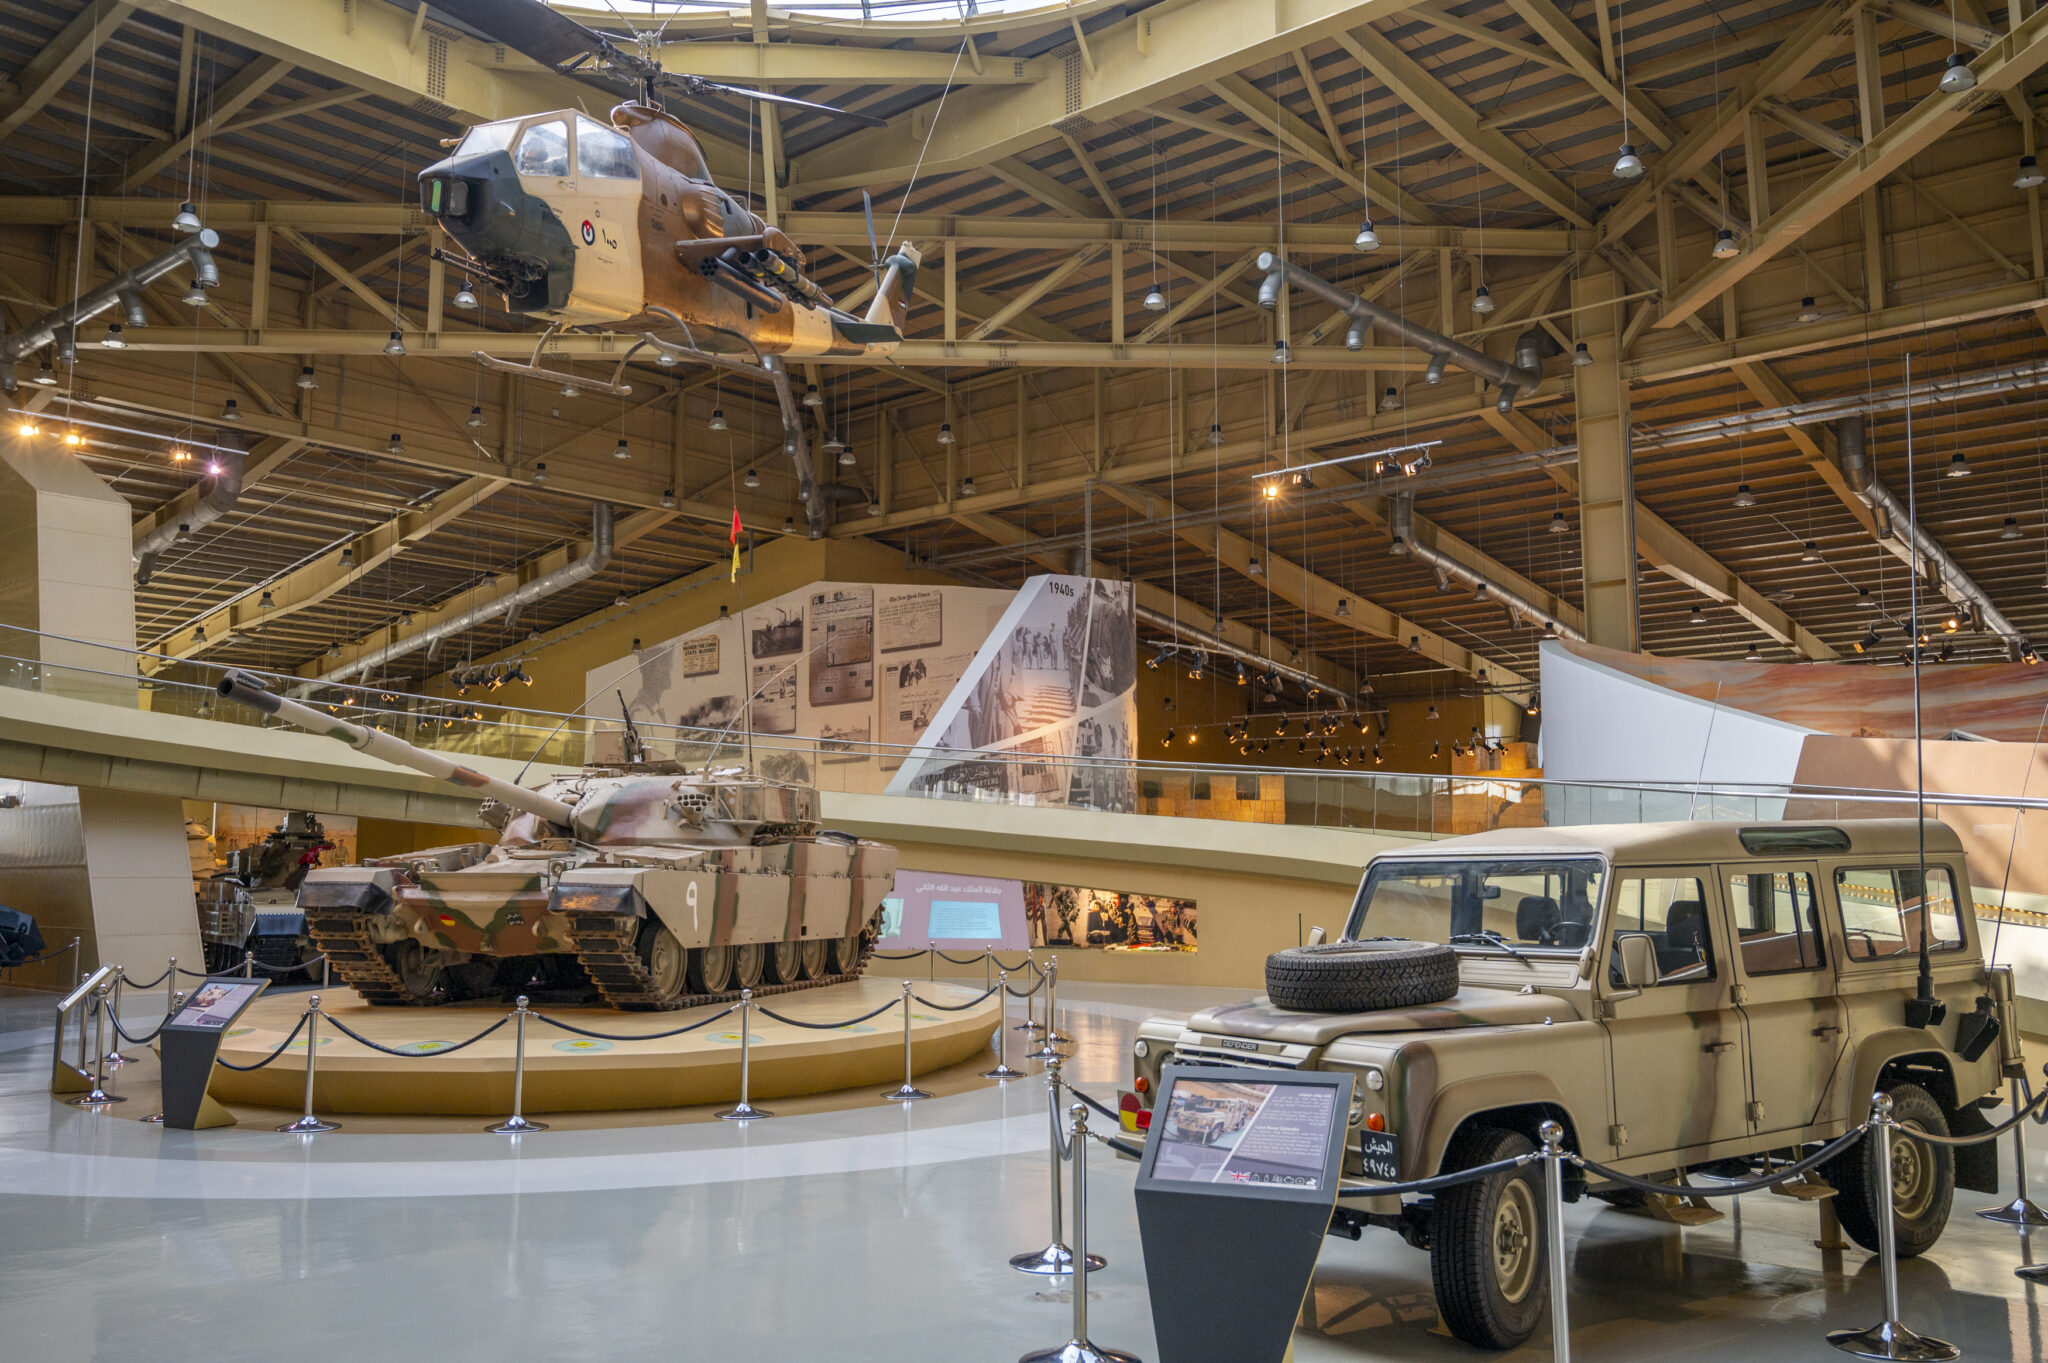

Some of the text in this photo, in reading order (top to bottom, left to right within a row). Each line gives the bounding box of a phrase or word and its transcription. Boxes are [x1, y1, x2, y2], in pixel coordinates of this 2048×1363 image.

[1049, 581, 1074, 597] 1940s
[936, 883, 949, 892] الله
[963, 883, 983, 894] الملك
[1222, 1040, 1258, 1051] DEFENDER
[1364, 1136, 1394, 1156] الجيش
[1363, 1158, 1397, 1178] ٤٩٧٤٥
